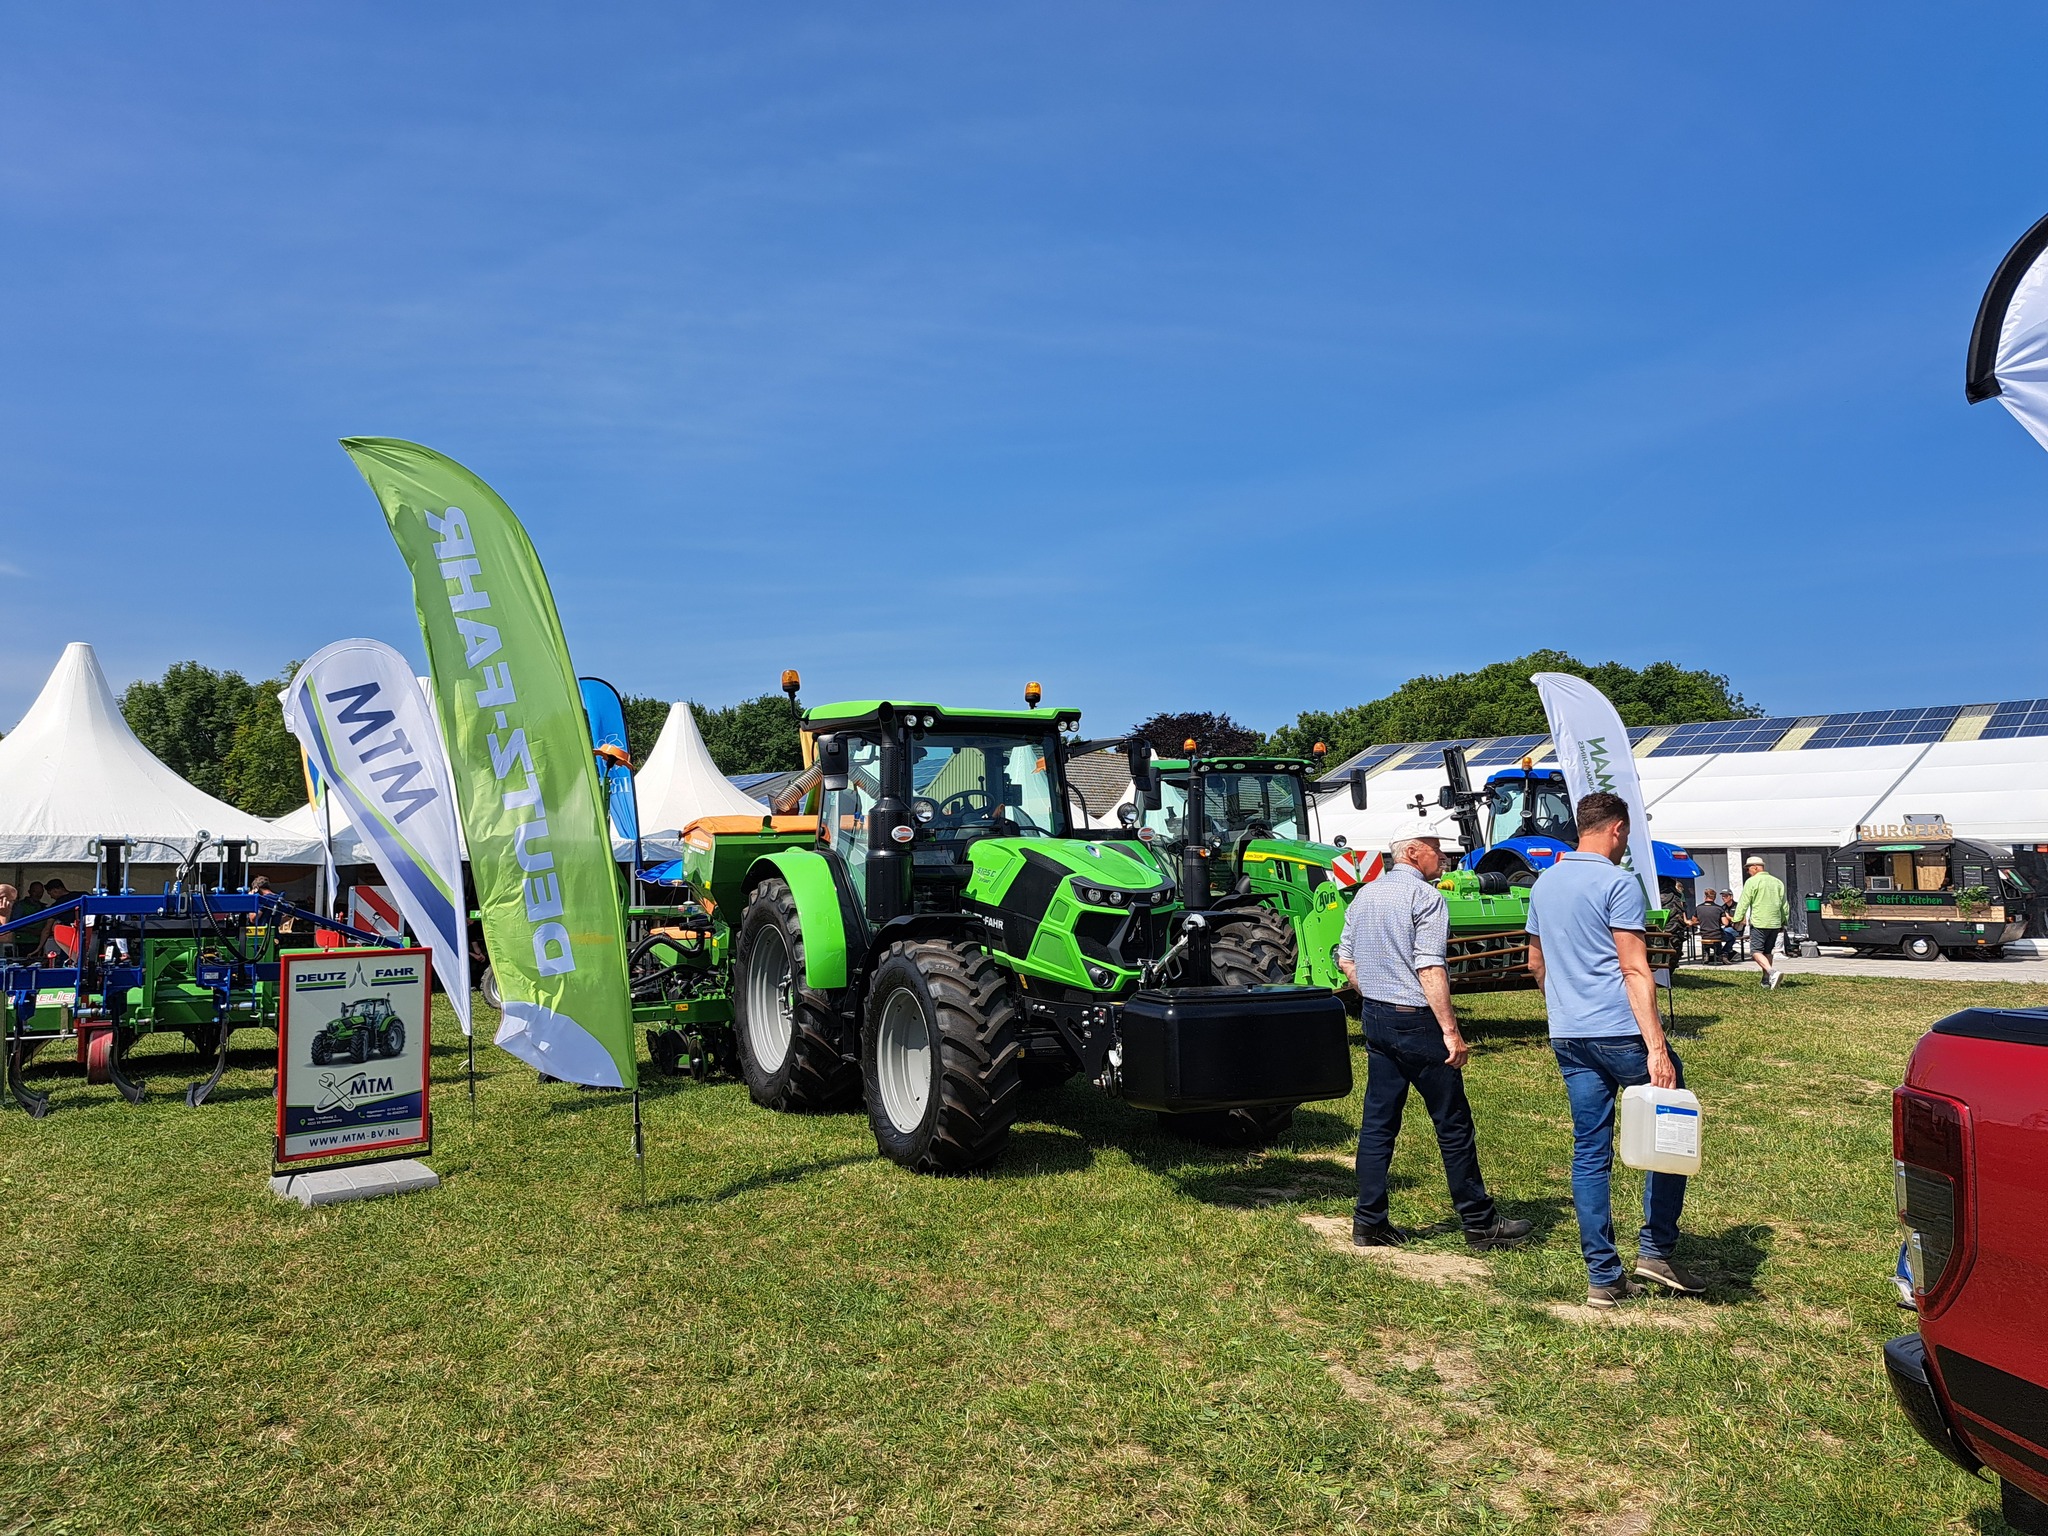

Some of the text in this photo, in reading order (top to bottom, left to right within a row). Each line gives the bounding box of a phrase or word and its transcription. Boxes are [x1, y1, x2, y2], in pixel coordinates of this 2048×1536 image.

[325, 681, 439, 825] MTM
[1860, 823, 1954, 838] BURGERS
[1316, 890, 1336, 912] AVR
[1876, 894, 1943, 905] Steff's Kitchen
[295, 967, 415, 983] DEUTZ FAHR
[350, 1076, 394, 1096] MTM
[309, 1128, 401, 1147] WWW.MTM-BV.NL
